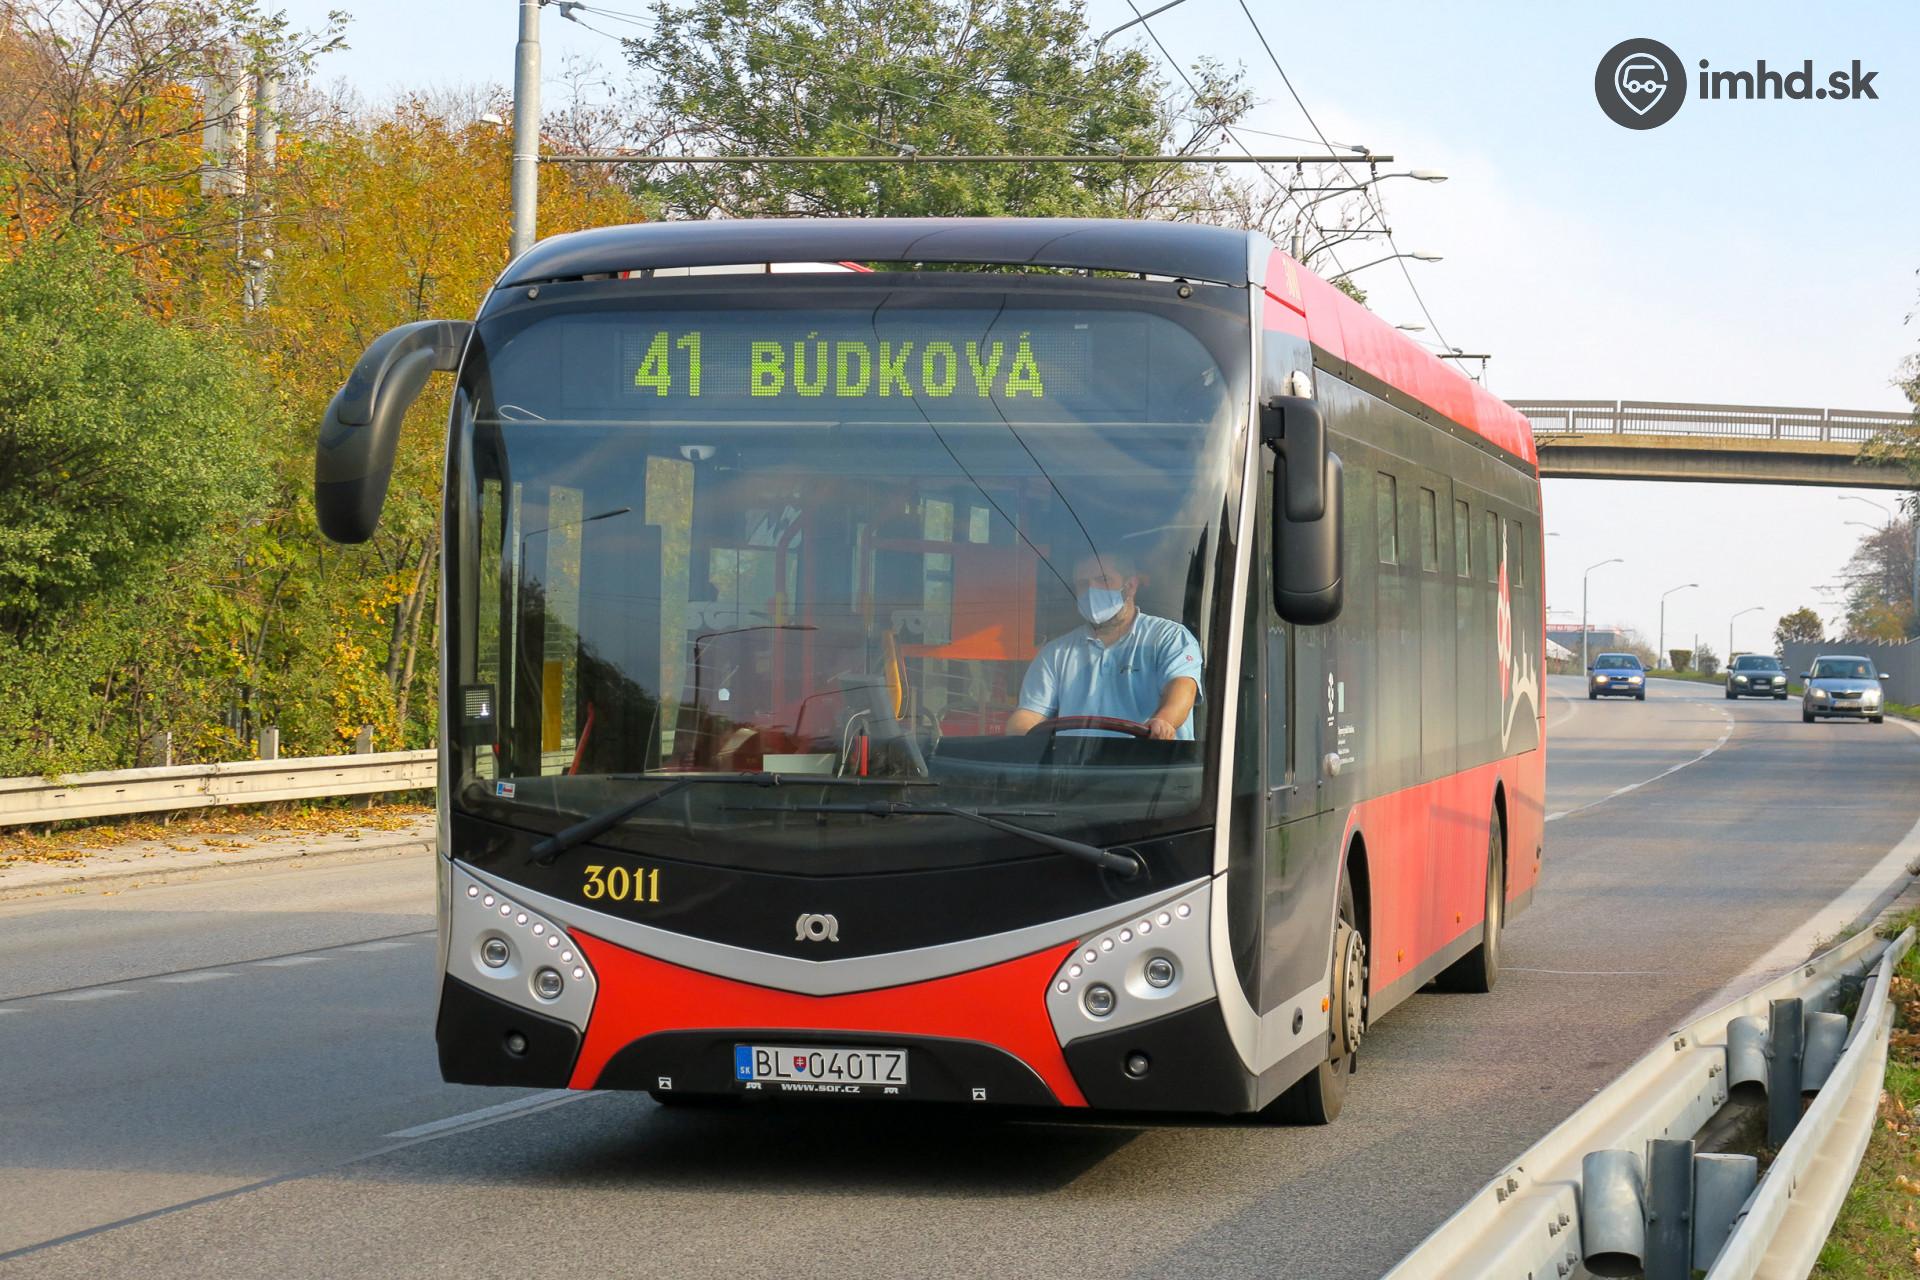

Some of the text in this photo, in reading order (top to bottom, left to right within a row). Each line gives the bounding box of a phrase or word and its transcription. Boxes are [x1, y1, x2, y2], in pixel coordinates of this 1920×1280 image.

[635, 331, 1044, 397] 41 BÚDKOVÁ
[583, 865, 660, 902] 3011
[740, 1066, 750, 1074] SK
[781, 1083, 860, 1094] www.sor.cz
